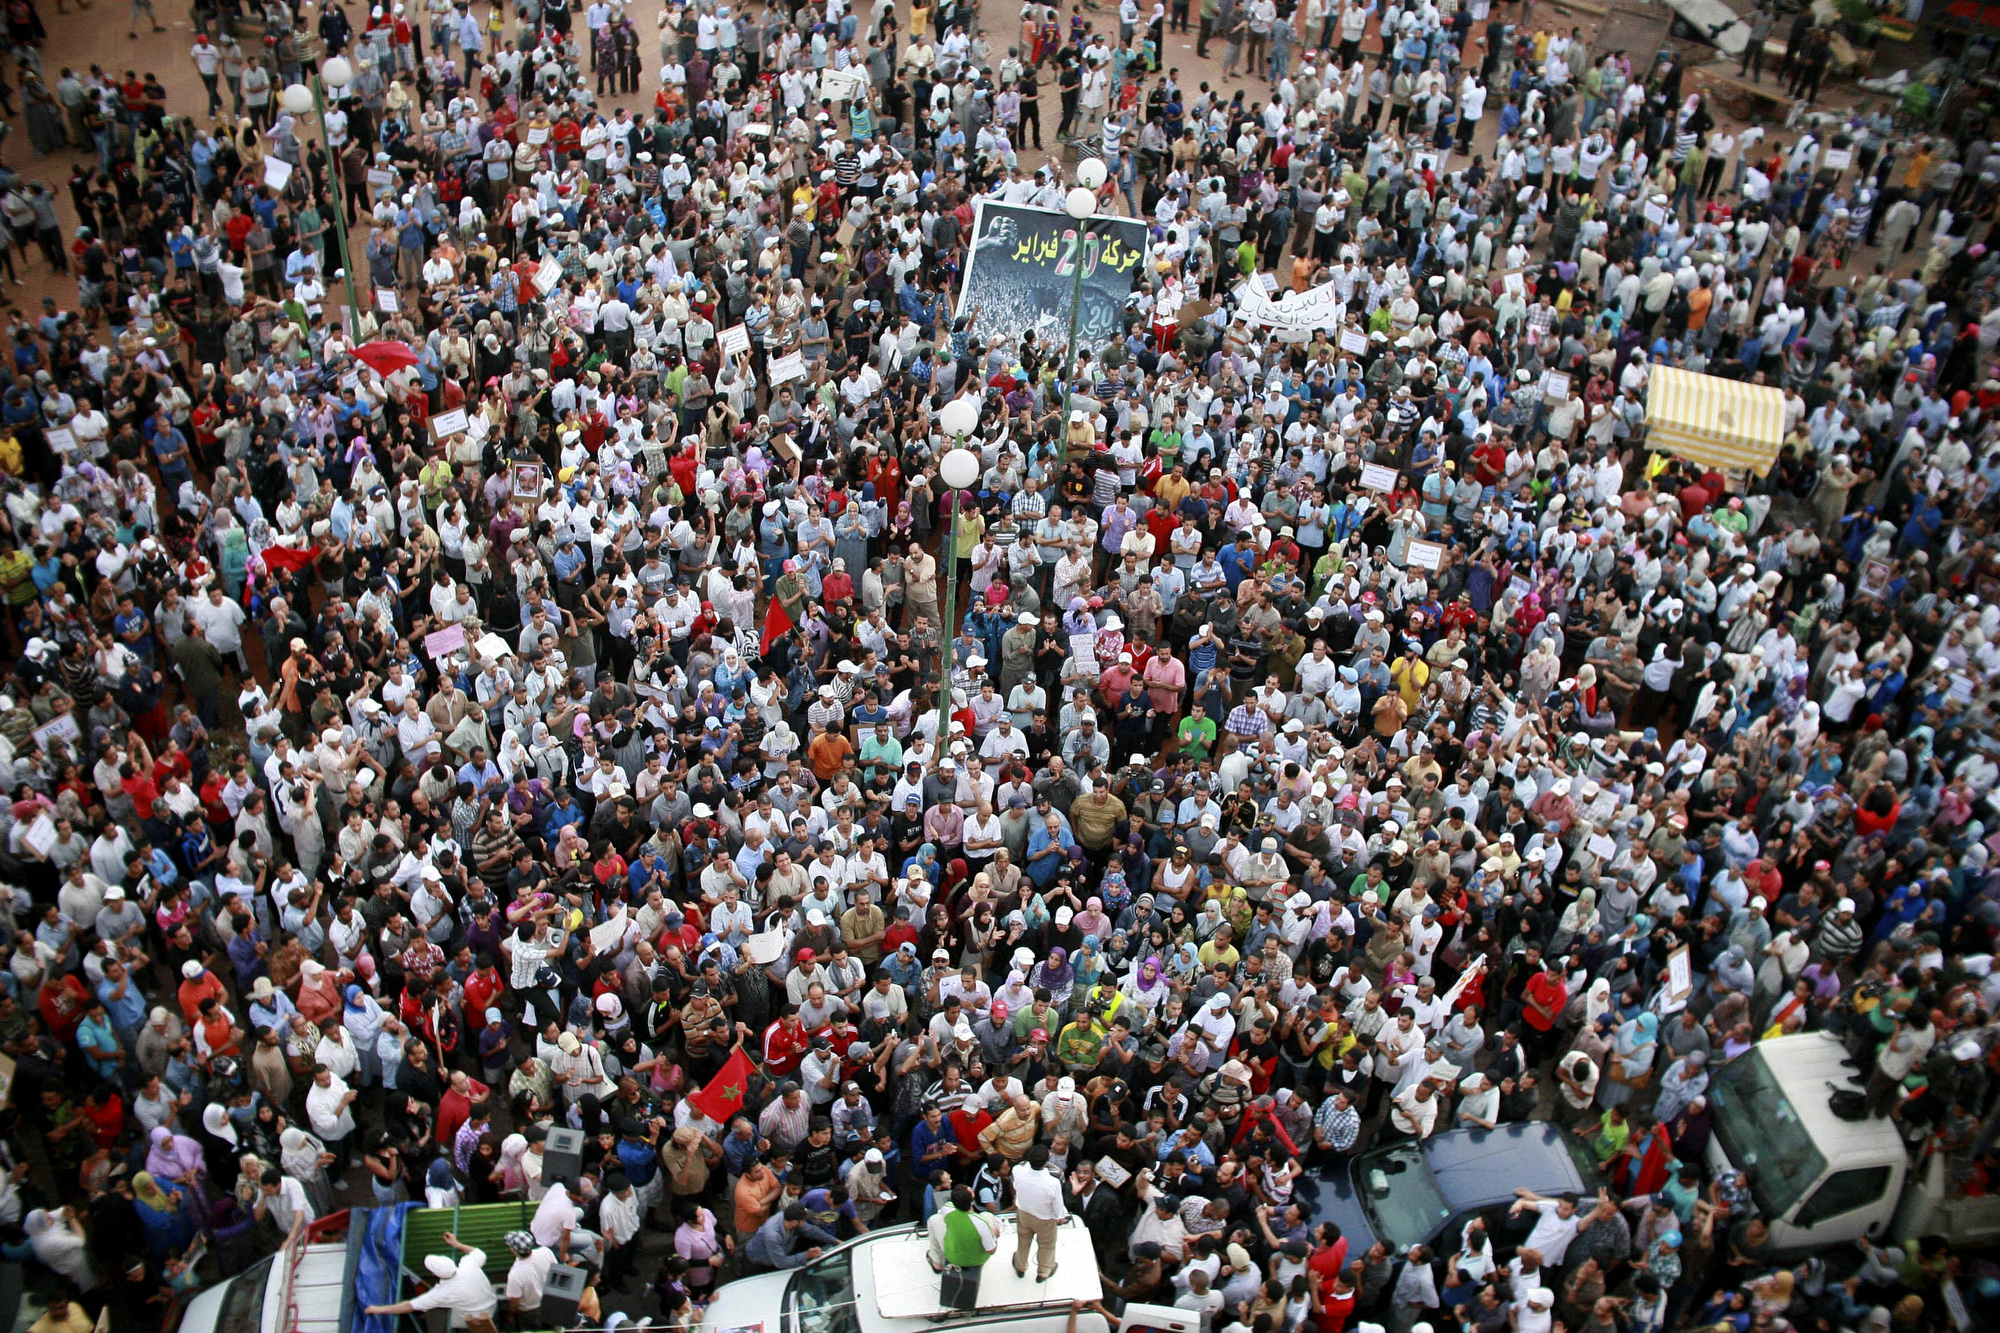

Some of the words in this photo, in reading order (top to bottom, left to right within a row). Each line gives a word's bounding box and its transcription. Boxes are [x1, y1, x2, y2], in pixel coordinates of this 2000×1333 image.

[1010, 229, 1059, 267] فبراير
[1054, 229, 1100, 279] 20
[1101, 233, 1141, 274] حركة
[1088, 304, 1114, 329] 20
[1240, 300, 1299, 325] العقاب
[1300, 312, 1329, 325] من
